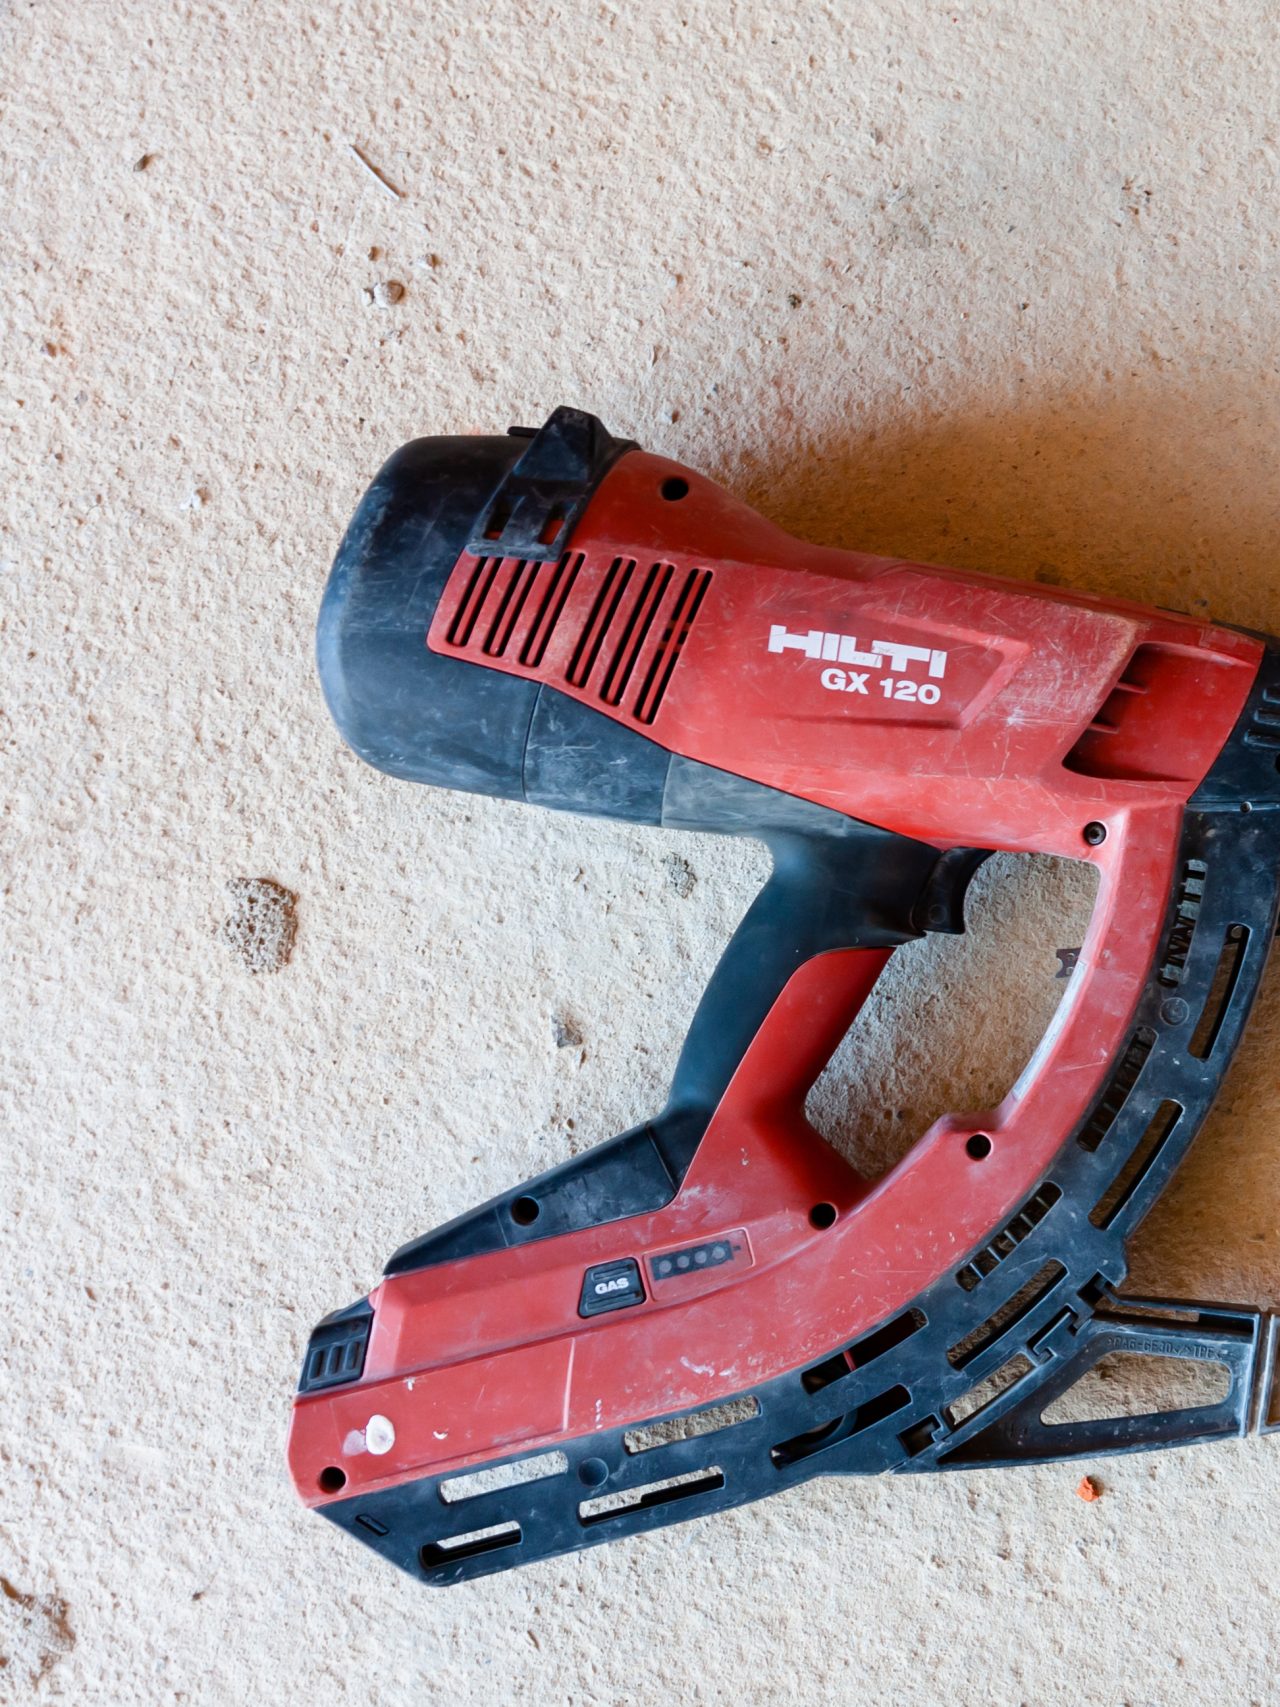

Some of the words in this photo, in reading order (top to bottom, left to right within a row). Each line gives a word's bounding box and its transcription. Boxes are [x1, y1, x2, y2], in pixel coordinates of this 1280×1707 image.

[767, 624, 948, 678] HILTI
[820, 667, 870, 695] GX
[879, 677, 941, 705] 120
[594, 1277, 630, 1295] GAS
